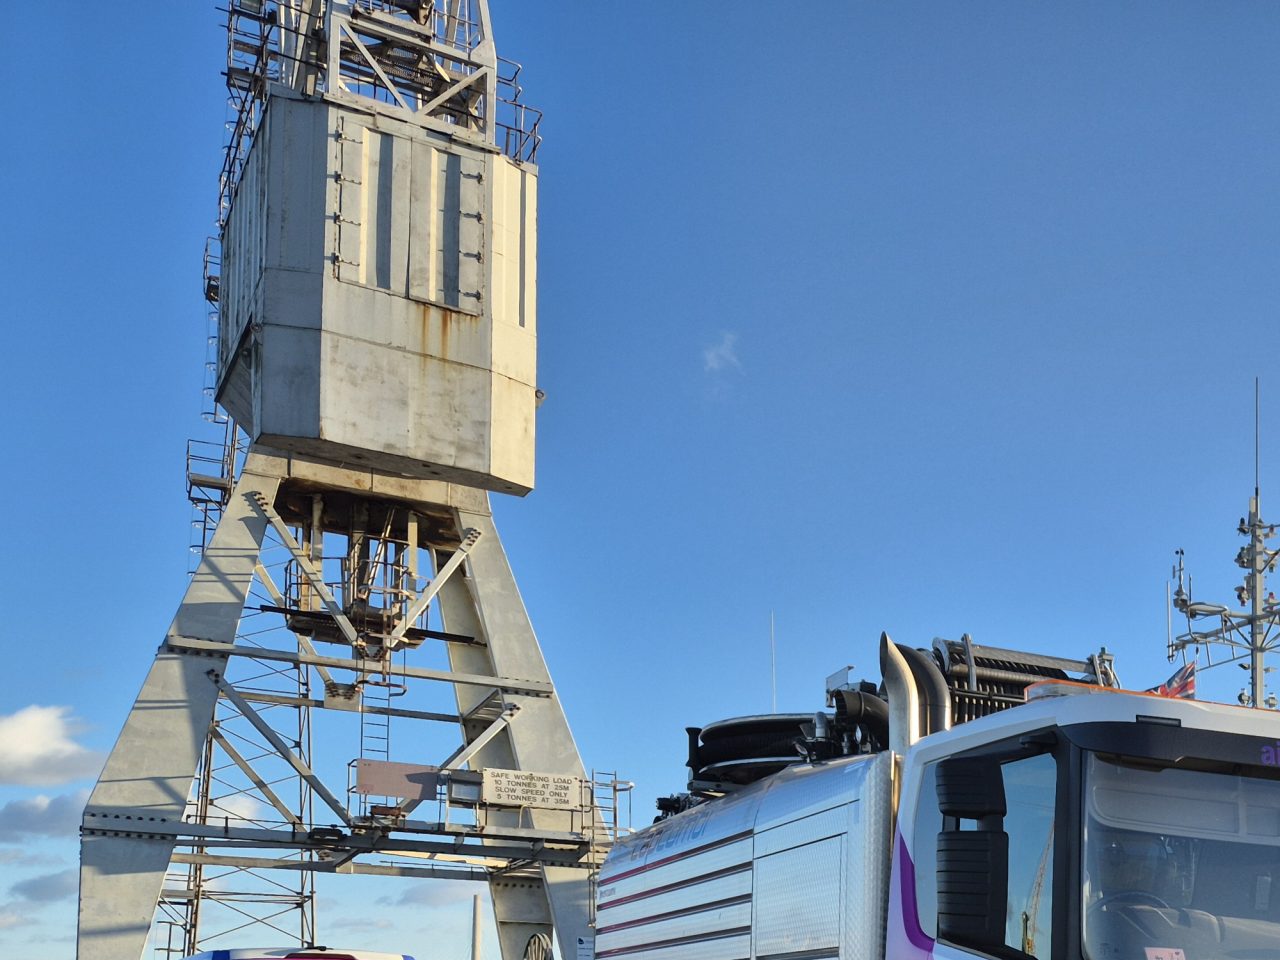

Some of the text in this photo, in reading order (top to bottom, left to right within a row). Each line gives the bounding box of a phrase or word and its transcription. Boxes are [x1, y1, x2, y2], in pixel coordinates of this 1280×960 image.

[490, 771, 510, 779] SAFE
[514, 774, 549, 783] WORKING
[507, 780, 537, 788] TONNES
[495, 786, 517, 794] SLOW
[521, 788, 545, 796] SPEED
[507, 794, 537, 802] TONNES
